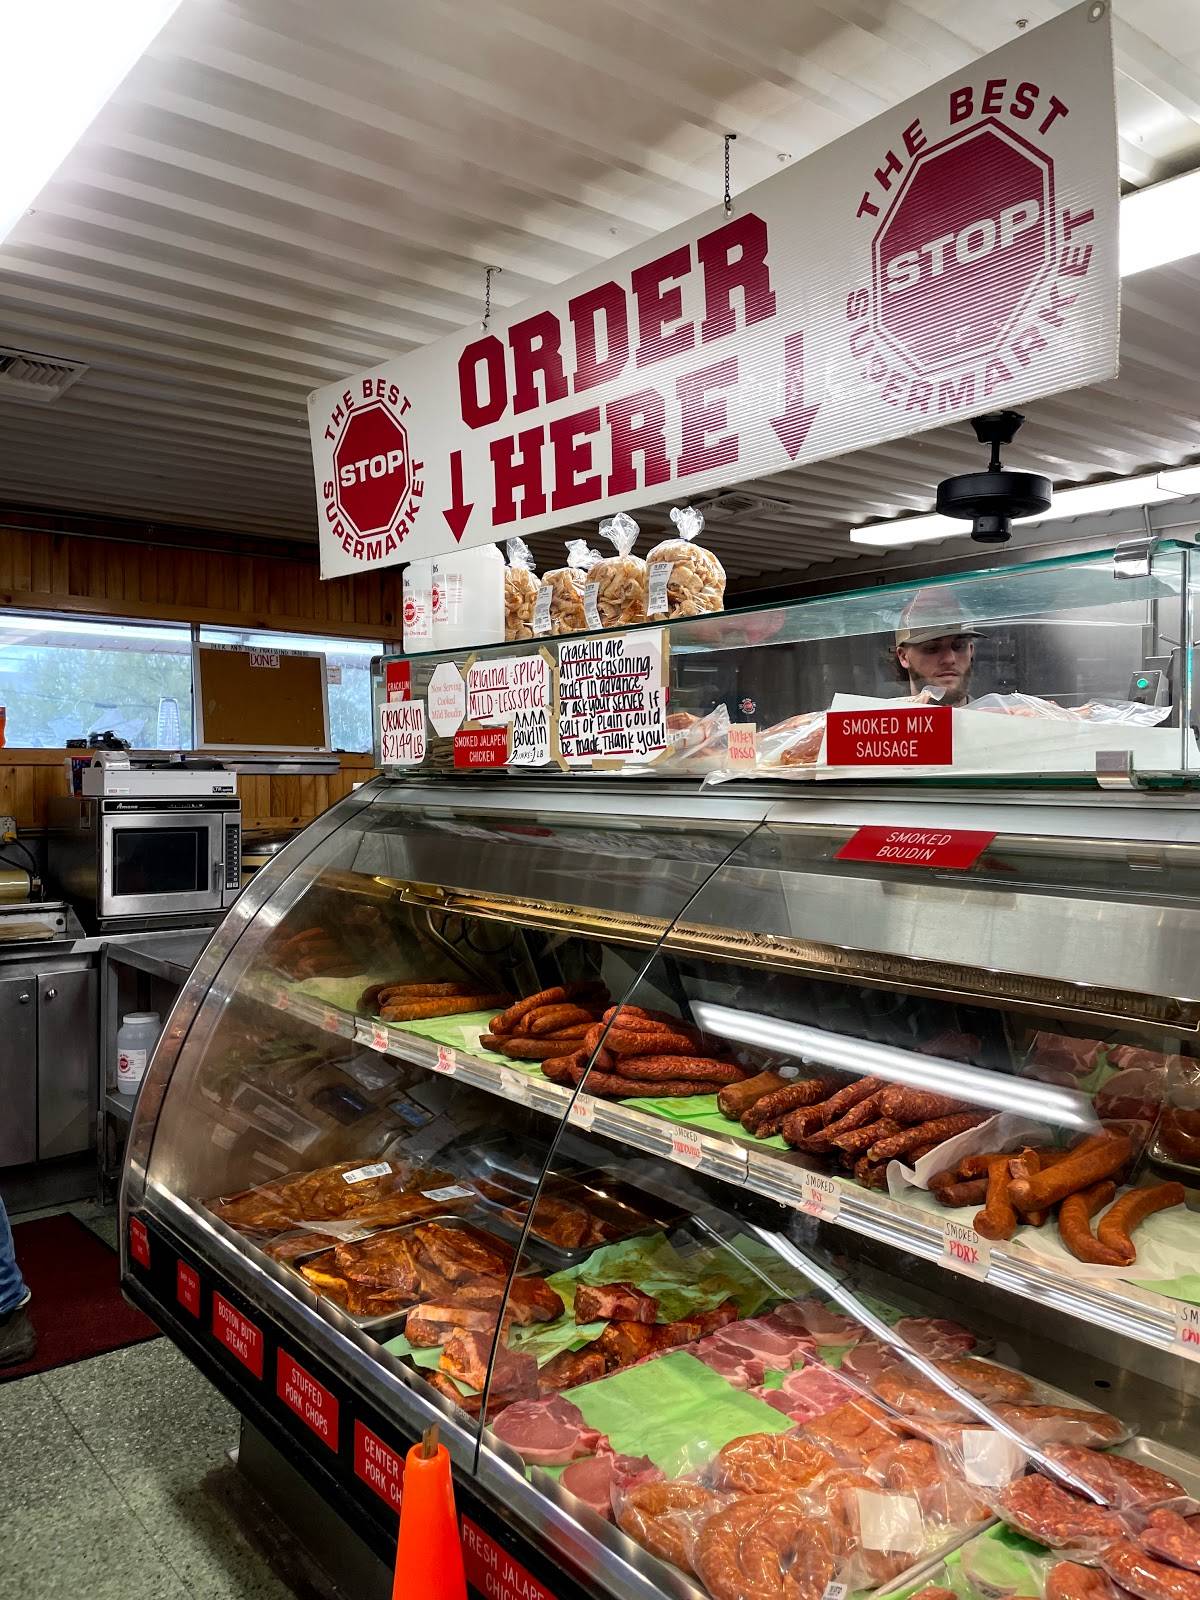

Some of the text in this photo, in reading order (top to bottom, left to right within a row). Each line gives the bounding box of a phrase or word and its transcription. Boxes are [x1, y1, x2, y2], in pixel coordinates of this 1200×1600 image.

[856, 78, 1069, 218] THE BEST
[886, 199, 1041, 293] STOP
[458, 212, 776, 430] ORDER
[325, 378, 412, 441] THE BEST
[490, 355, 739, 527] HERE
[340, 449, 404, 487] STOP
[323, 459, 425, 561] SUPERMARKET
[605, 640, 624, 658] are
[560, 663, 573, 680] all
[575, 661, 594, 677] one
[438, 695, 456, 706] Cooked
[469, 694, 493, 716] MILD
[560, 700, 569, 717] or
[572, 700, 588, 715] ask
[588, 697, 611, 718] your
[583, 717, 593, 734] or
[842, 715, 934, 736] SMOKED MIX
[454, 735, 478, 748] SMOKED
[561, 740, 573, 755] be
[856, 739, 919, 758] SAUSAGE
[469, 750, 495, 763] CHICKEN
[885, 831, 952, 846] SMOKED
[875, 845, 937, 861] BOUDIN
[805, 1173, 835, 1194] SMOKED
[945, 1222, 979, 1244] SMOKED
[949, 1240, 980, 1264] PORK
[218, 1301, 257, 1346] BOSTON BUTT
[225, 1327, 248, 1359] STEAKS
[291, 1367, 323, 1408] STUFFED
[285, 1382, 328, 1436] PORK CHOPS
[364, 1435, 399, 1479] CENTER
[365, 1458, 387, 1493] PORK
[462, 1522, 498, 1571] FRESH
